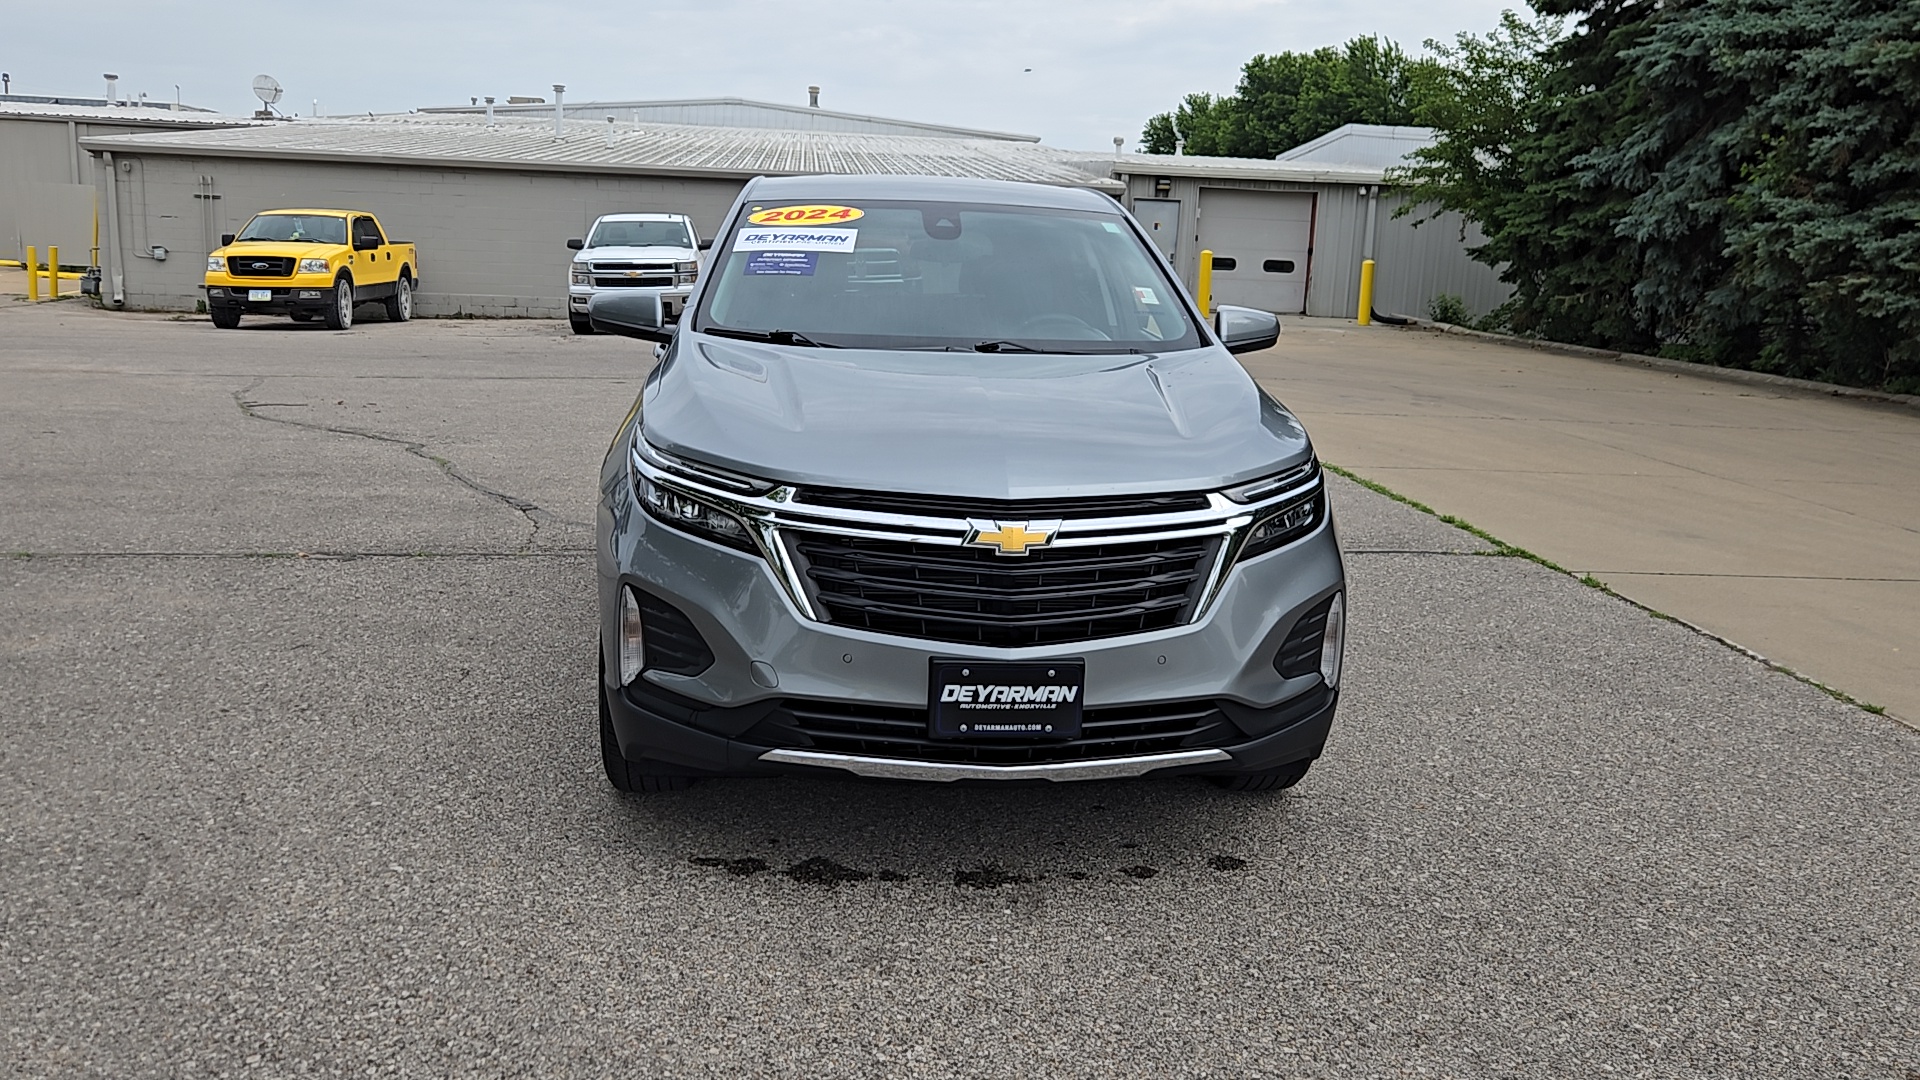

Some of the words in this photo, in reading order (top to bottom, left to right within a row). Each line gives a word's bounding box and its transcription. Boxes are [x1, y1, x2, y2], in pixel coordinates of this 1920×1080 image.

[759, 209, 852, 222] 2024
[744, 234, 849, 242] DEYARMAN
[940, 685, 1078, 702] DEYARMAN
